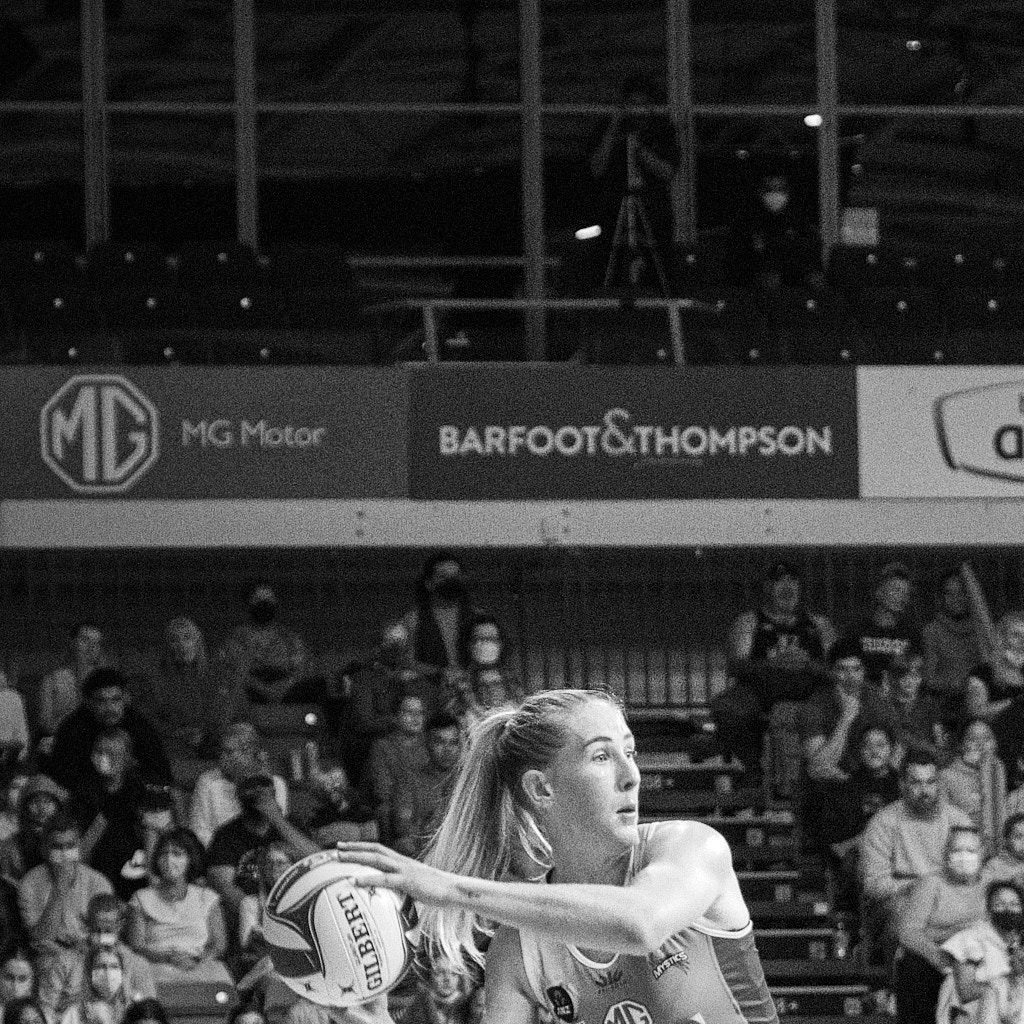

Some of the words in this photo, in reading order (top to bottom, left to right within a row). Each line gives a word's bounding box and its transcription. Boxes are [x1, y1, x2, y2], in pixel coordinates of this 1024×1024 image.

[44, 378, 153, 488] MG
[182, 420, 233, 447] MG
[240, 418, 325, 447] Motor
[336, 893, 383, 992] GILBERT
